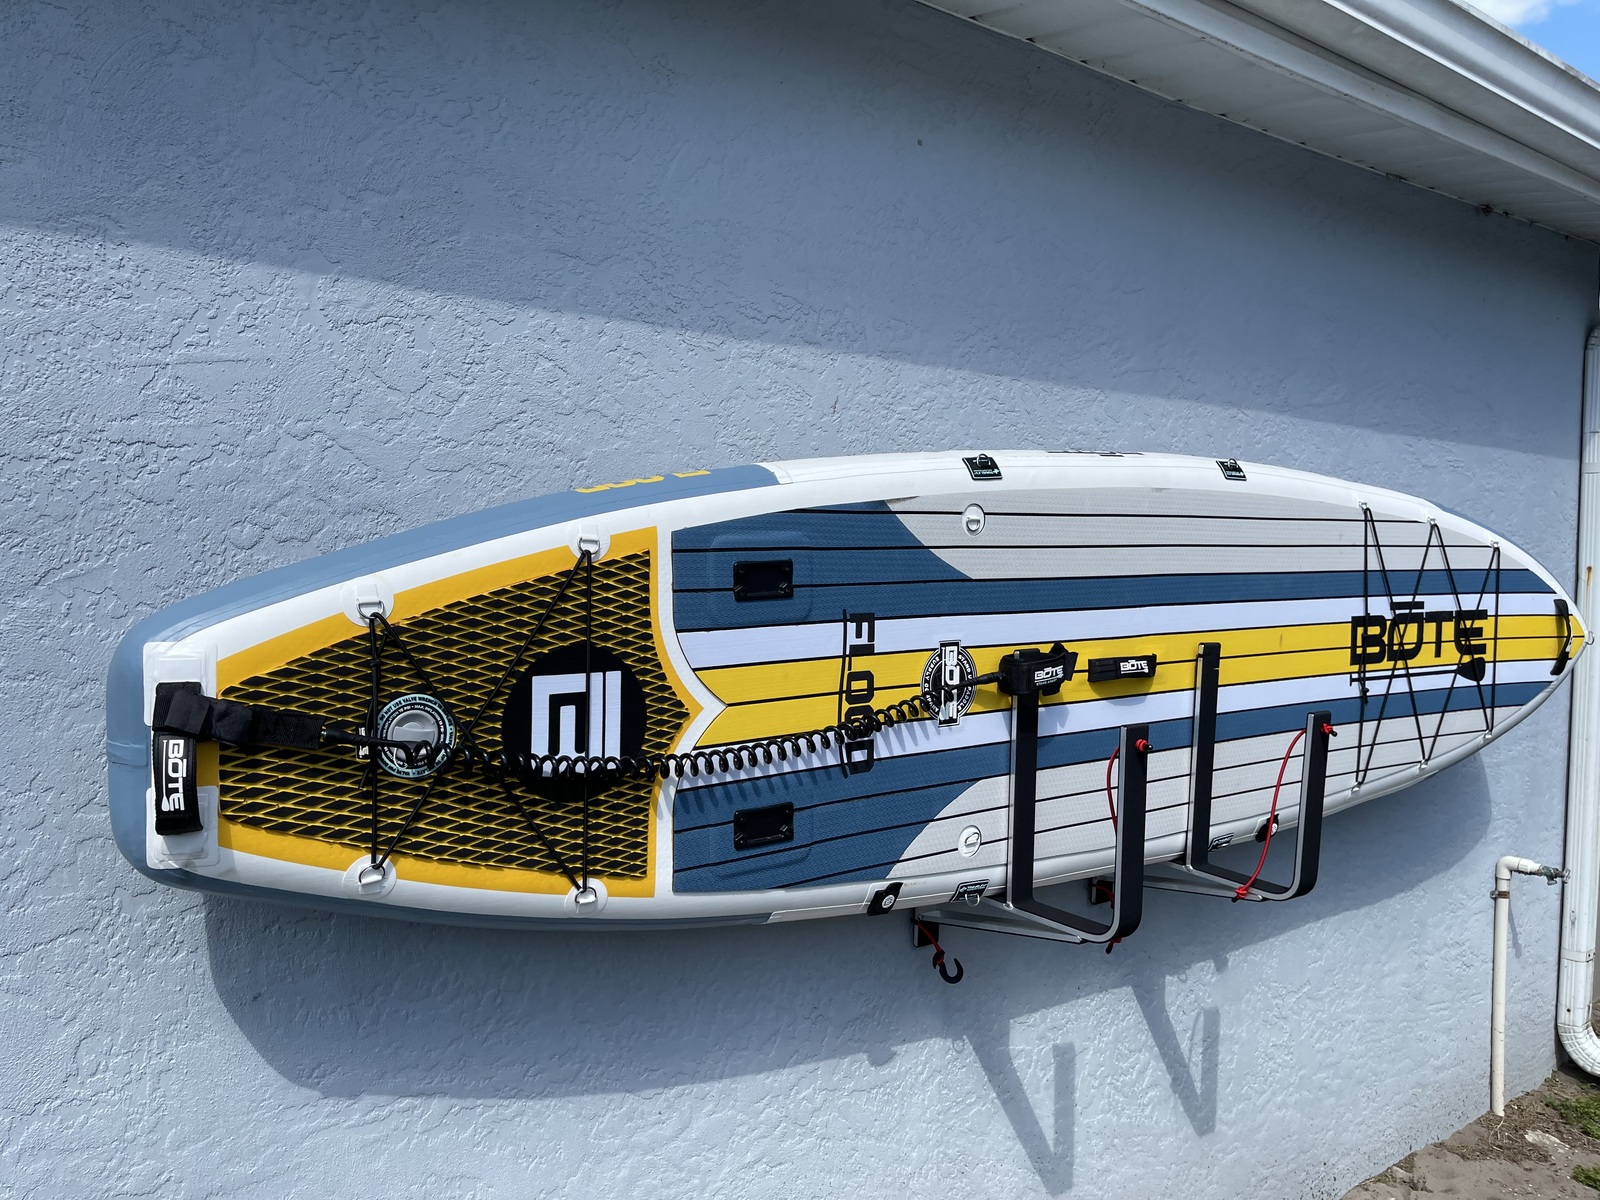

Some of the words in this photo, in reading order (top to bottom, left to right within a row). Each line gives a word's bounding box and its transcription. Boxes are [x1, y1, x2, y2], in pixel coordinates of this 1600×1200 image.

[958, 654, 972, 672] STAND
[401, 696, 417, 705] VALVE
[957, 686, 972, 711] PADDLE
